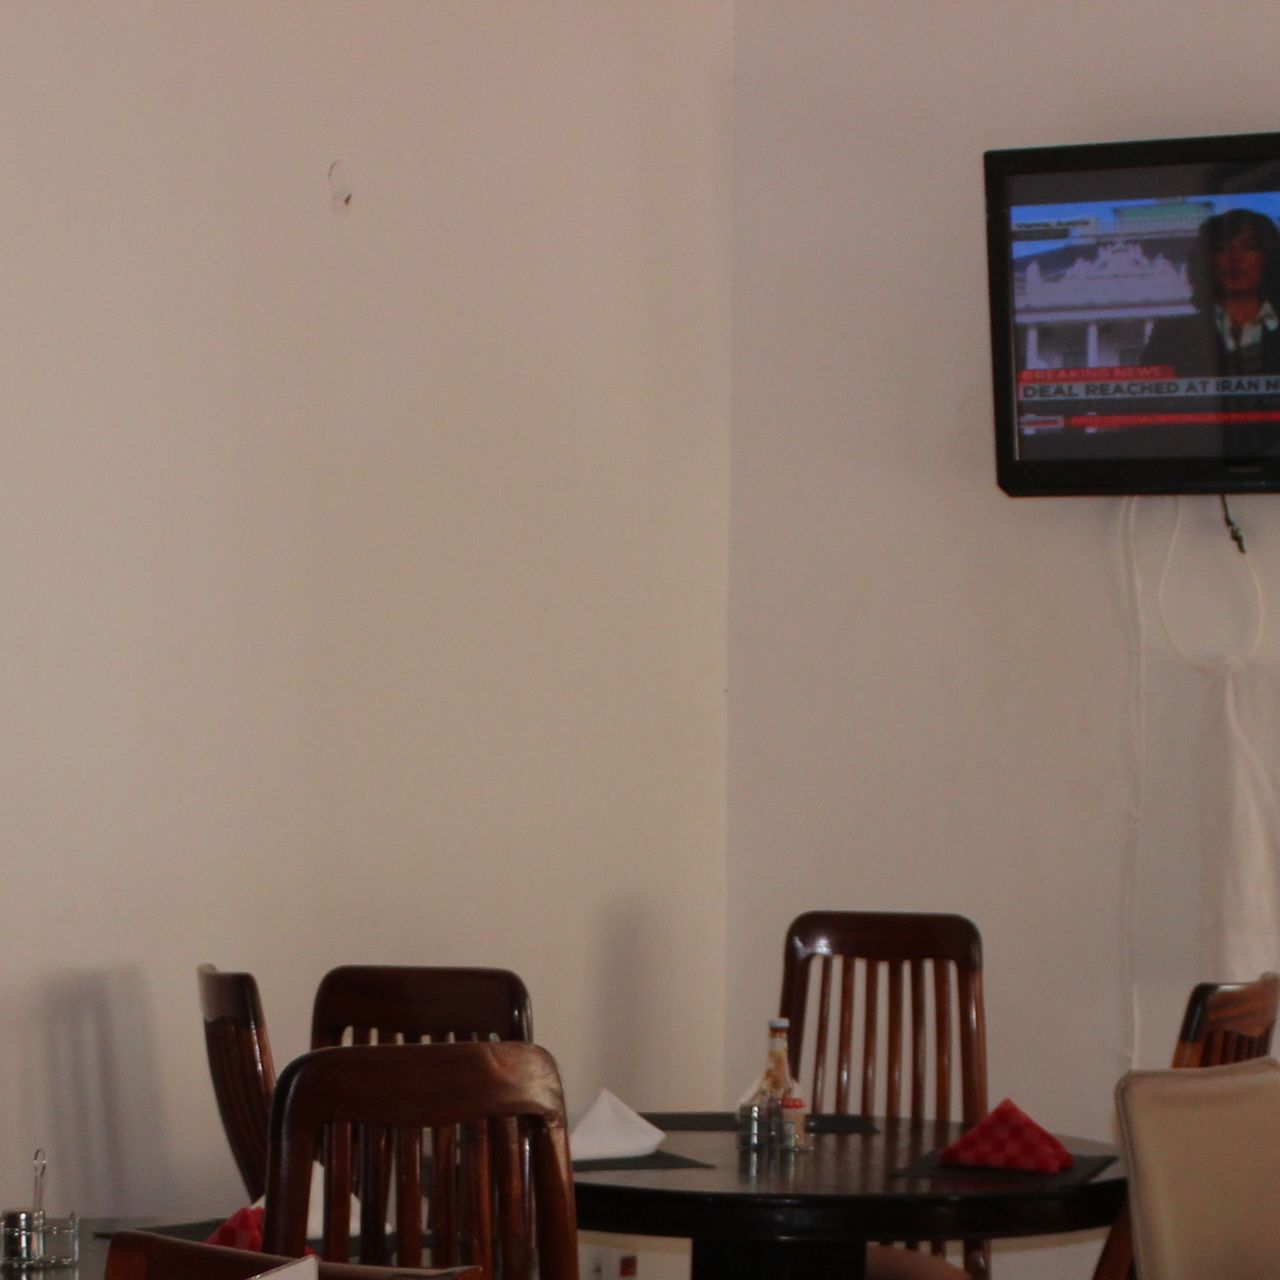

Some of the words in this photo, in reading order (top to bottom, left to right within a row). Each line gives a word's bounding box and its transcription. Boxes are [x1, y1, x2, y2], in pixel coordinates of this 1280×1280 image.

[1023, 383, 1078, 398] DEAL
[1085, 381, 1180, 396] REACHED
[1186, 380, 1212, 393] AT
[1216, 378, 1260, 392] IRAN
